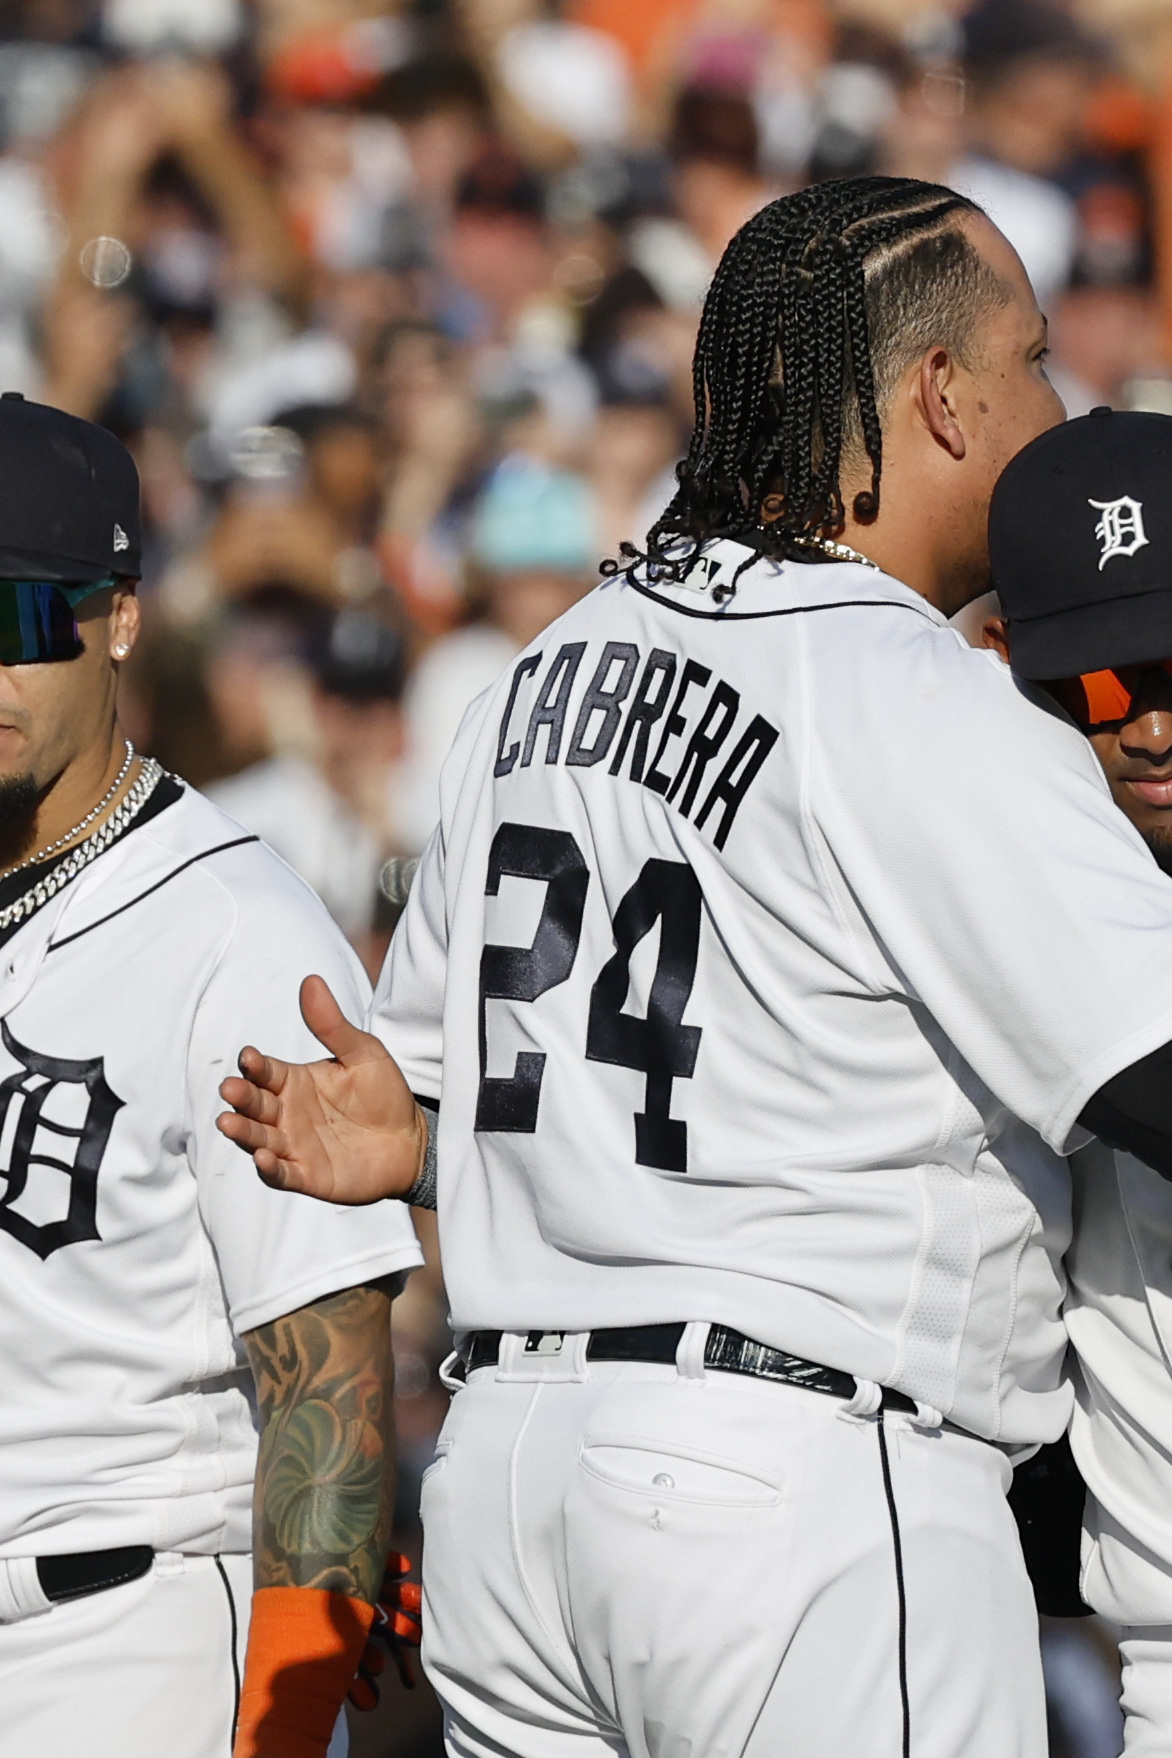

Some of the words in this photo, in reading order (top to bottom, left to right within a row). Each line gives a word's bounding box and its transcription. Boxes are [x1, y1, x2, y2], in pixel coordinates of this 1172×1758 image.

[1088, 495, 1150, 571] D
[494, 640, 780, 853] CABRERA
[473, 822, 702, 1173] 24
